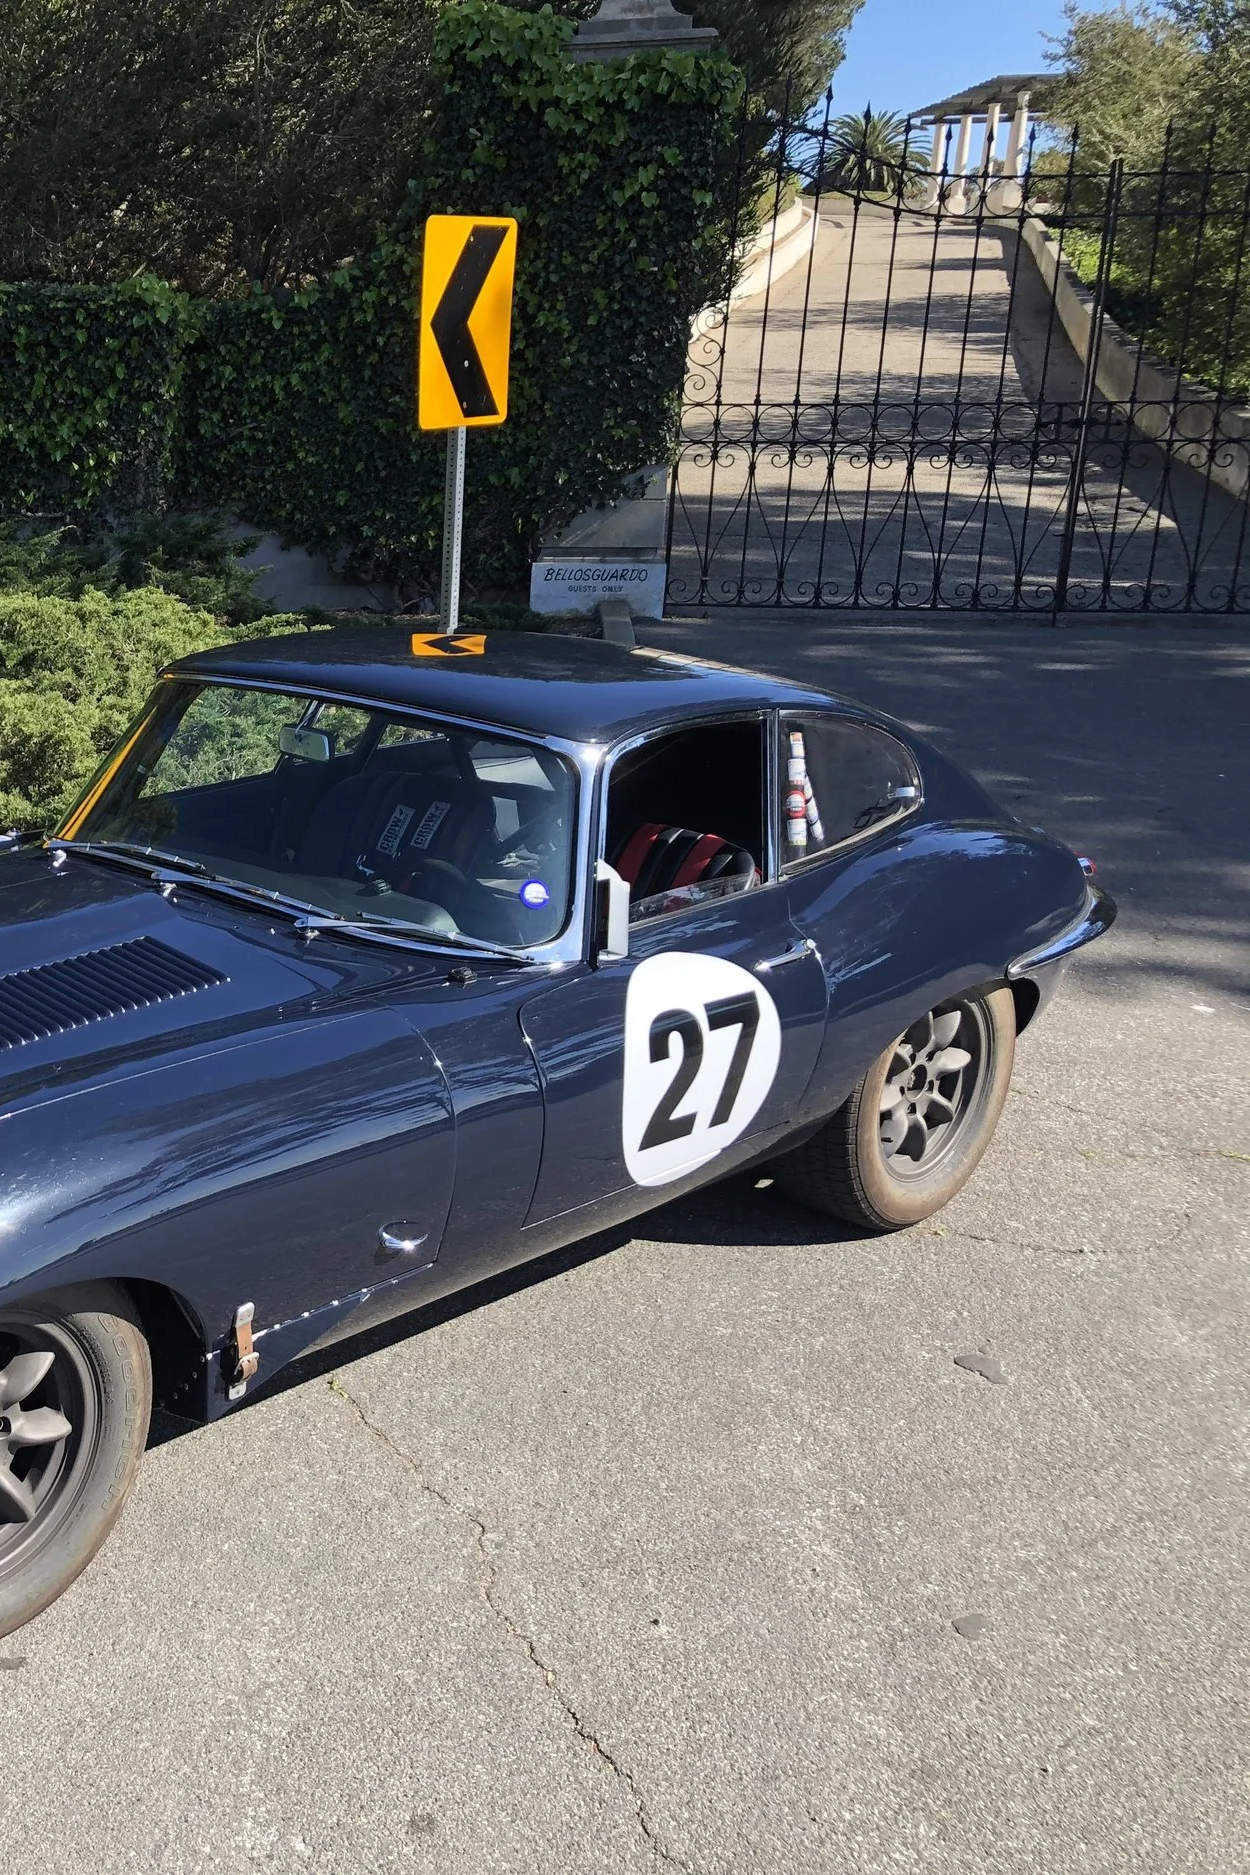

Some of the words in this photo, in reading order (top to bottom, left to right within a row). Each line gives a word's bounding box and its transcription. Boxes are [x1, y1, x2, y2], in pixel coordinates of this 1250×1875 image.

[544, 567, 648, 582] BELLOSGUARDO
[568, 585, 597, 593] GUESTS
[601, 585, 624, 593] ONLY
[379, 815, 401, 850] CROW
[413, 811, 437, 845] CROW
[638, 989, 760, 1152] 27
